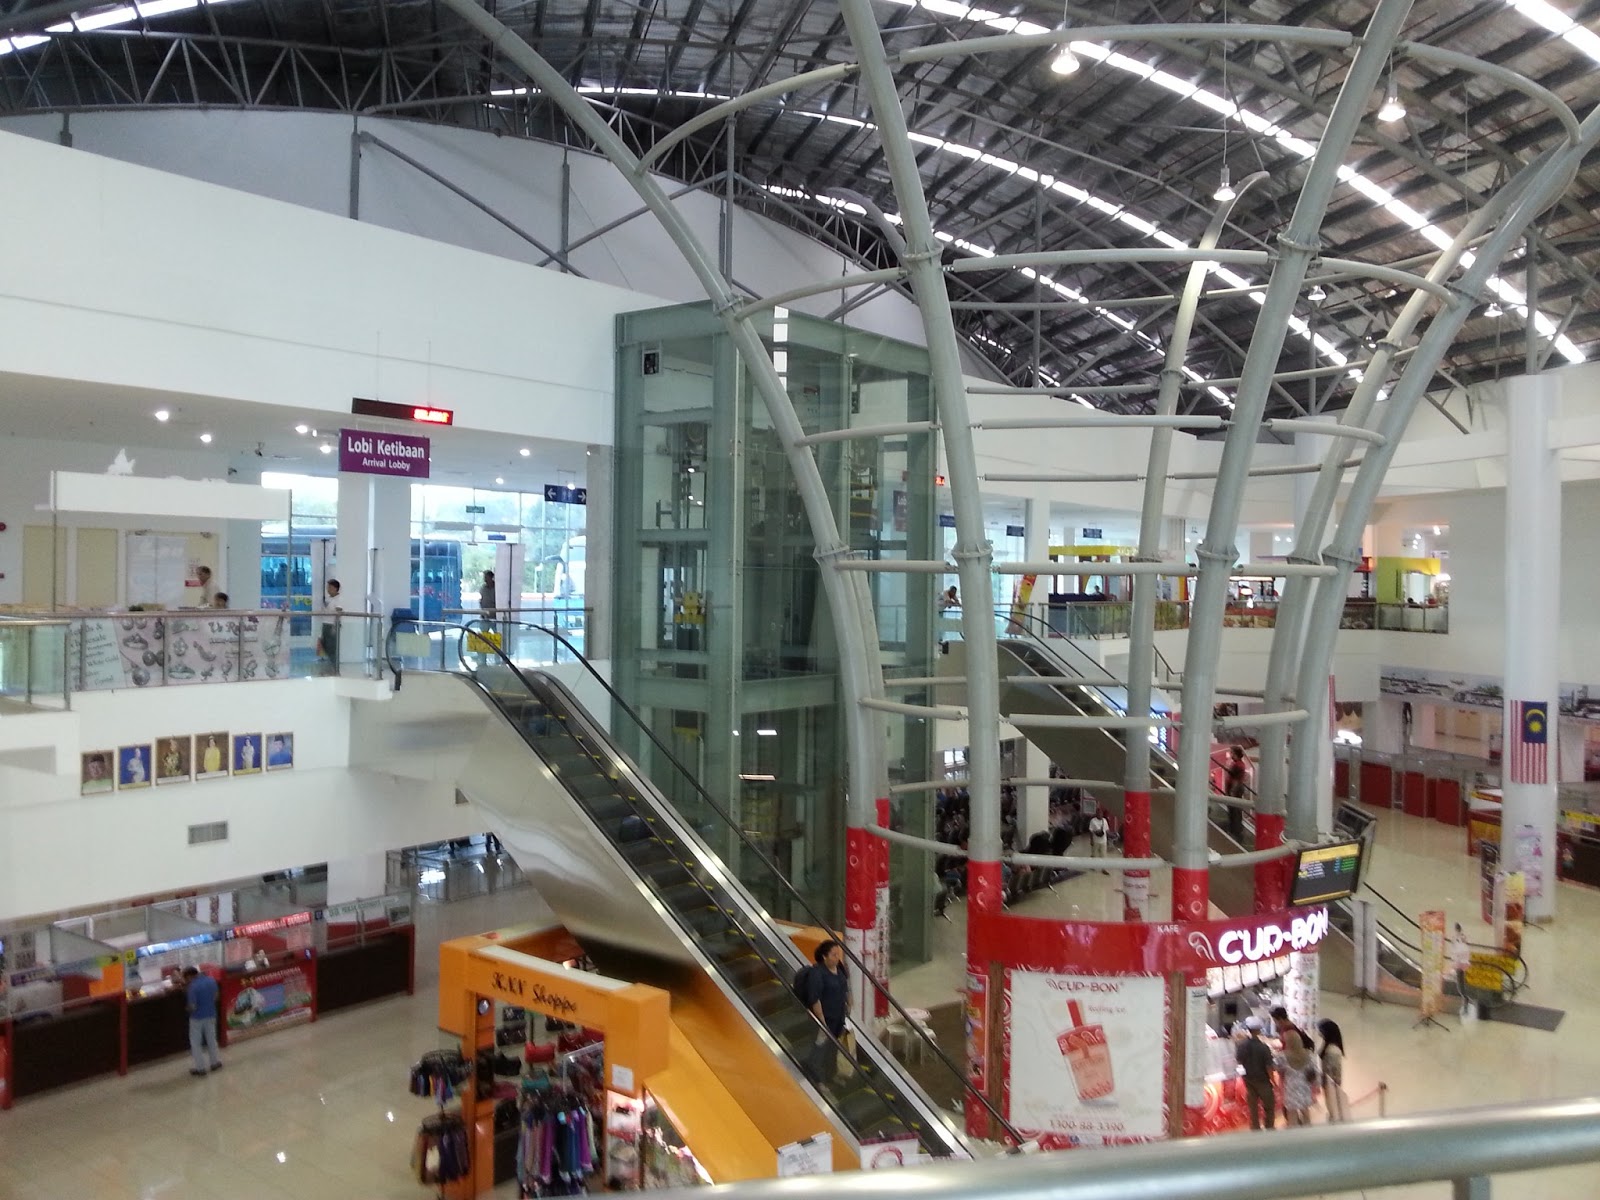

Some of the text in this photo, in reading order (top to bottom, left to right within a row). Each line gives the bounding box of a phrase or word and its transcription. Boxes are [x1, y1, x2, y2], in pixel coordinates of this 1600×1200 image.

[348, 436, 425, 459] Lobi Ketibaan
[362, 457, 411, 472] Arrival Lobby
[1157, 924, 1179, 934] KAFE
[1218, 907, 1329, 964] CUP-BON
[1058, 980, 1120, 993] CUP-BON
